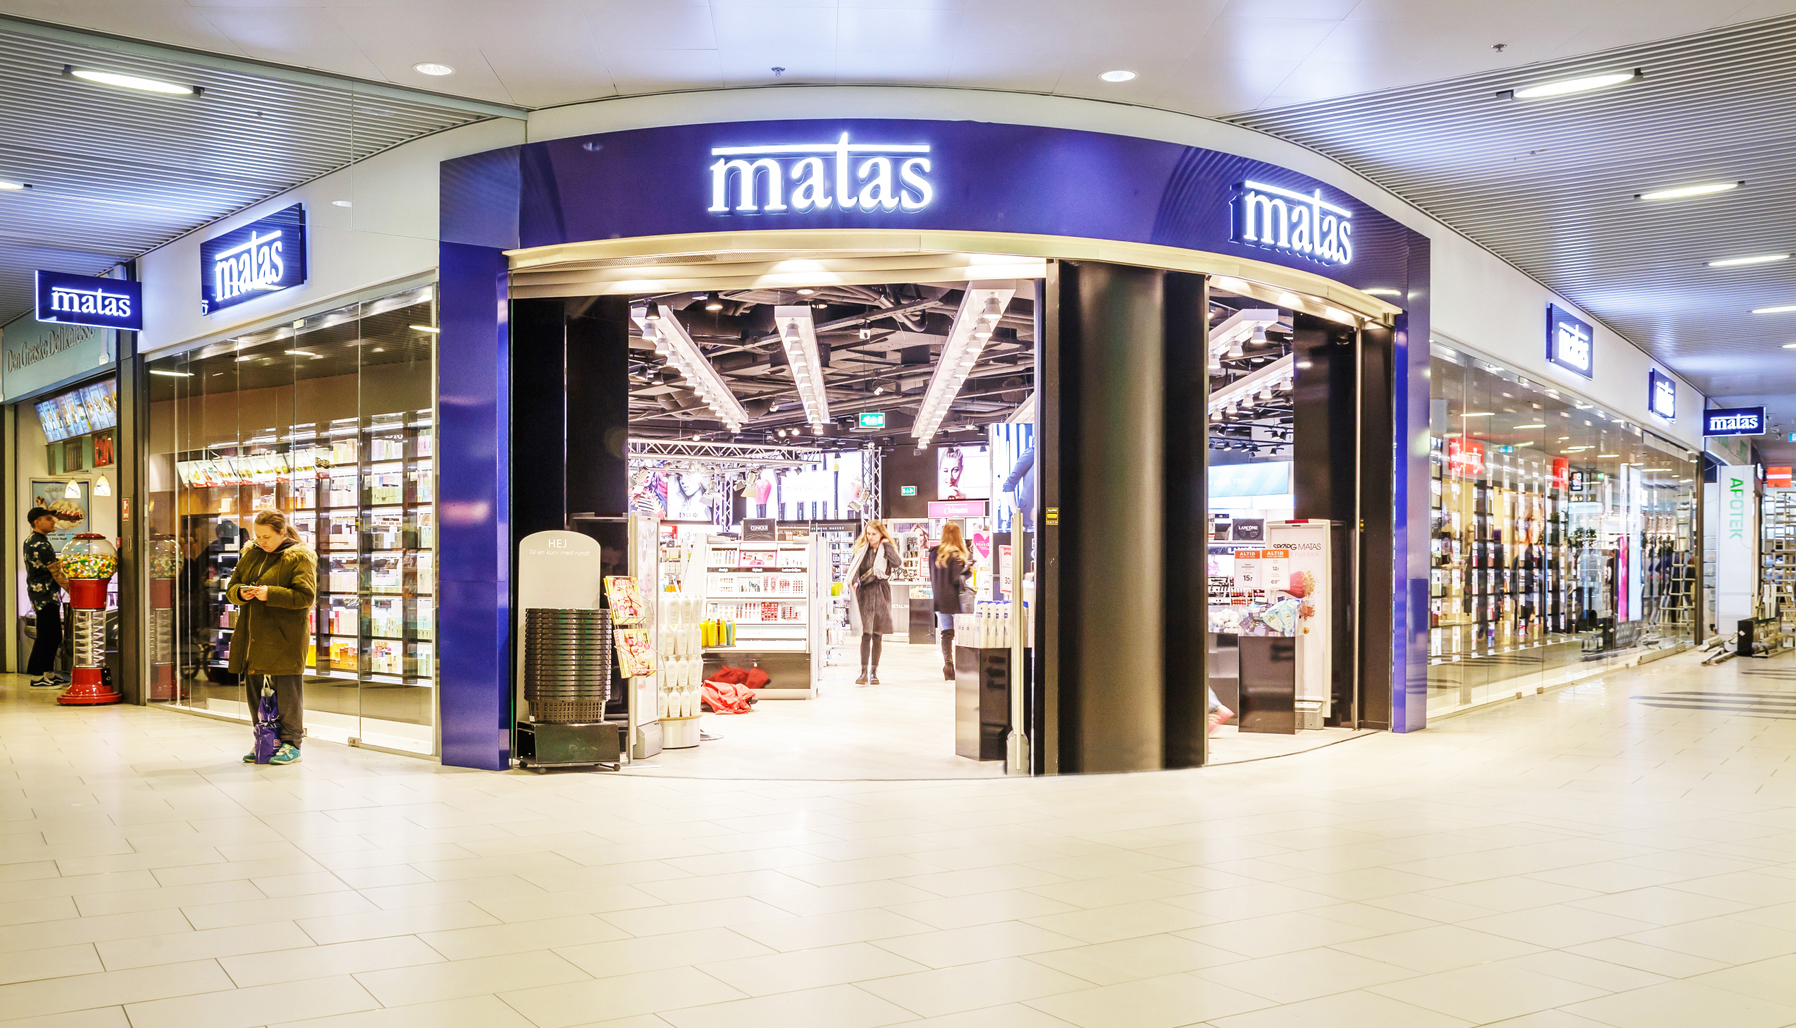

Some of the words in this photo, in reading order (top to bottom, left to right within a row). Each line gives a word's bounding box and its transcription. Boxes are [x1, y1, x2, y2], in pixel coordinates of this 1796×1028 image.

[708, 131, 933, 213] matas
[1243, 180, 1352, 265] matas
[214, 230, 284, 302] matas
[50, 286, 131, 317] matas
[6, 349, 21, 374] Den
[1709, 413, 1759, 431] matas
[1729, 477, 1744, 540] APOTEK
[548, 538, 568, 549] HEJ
[1297, 543, 1322, 551] MATAS
